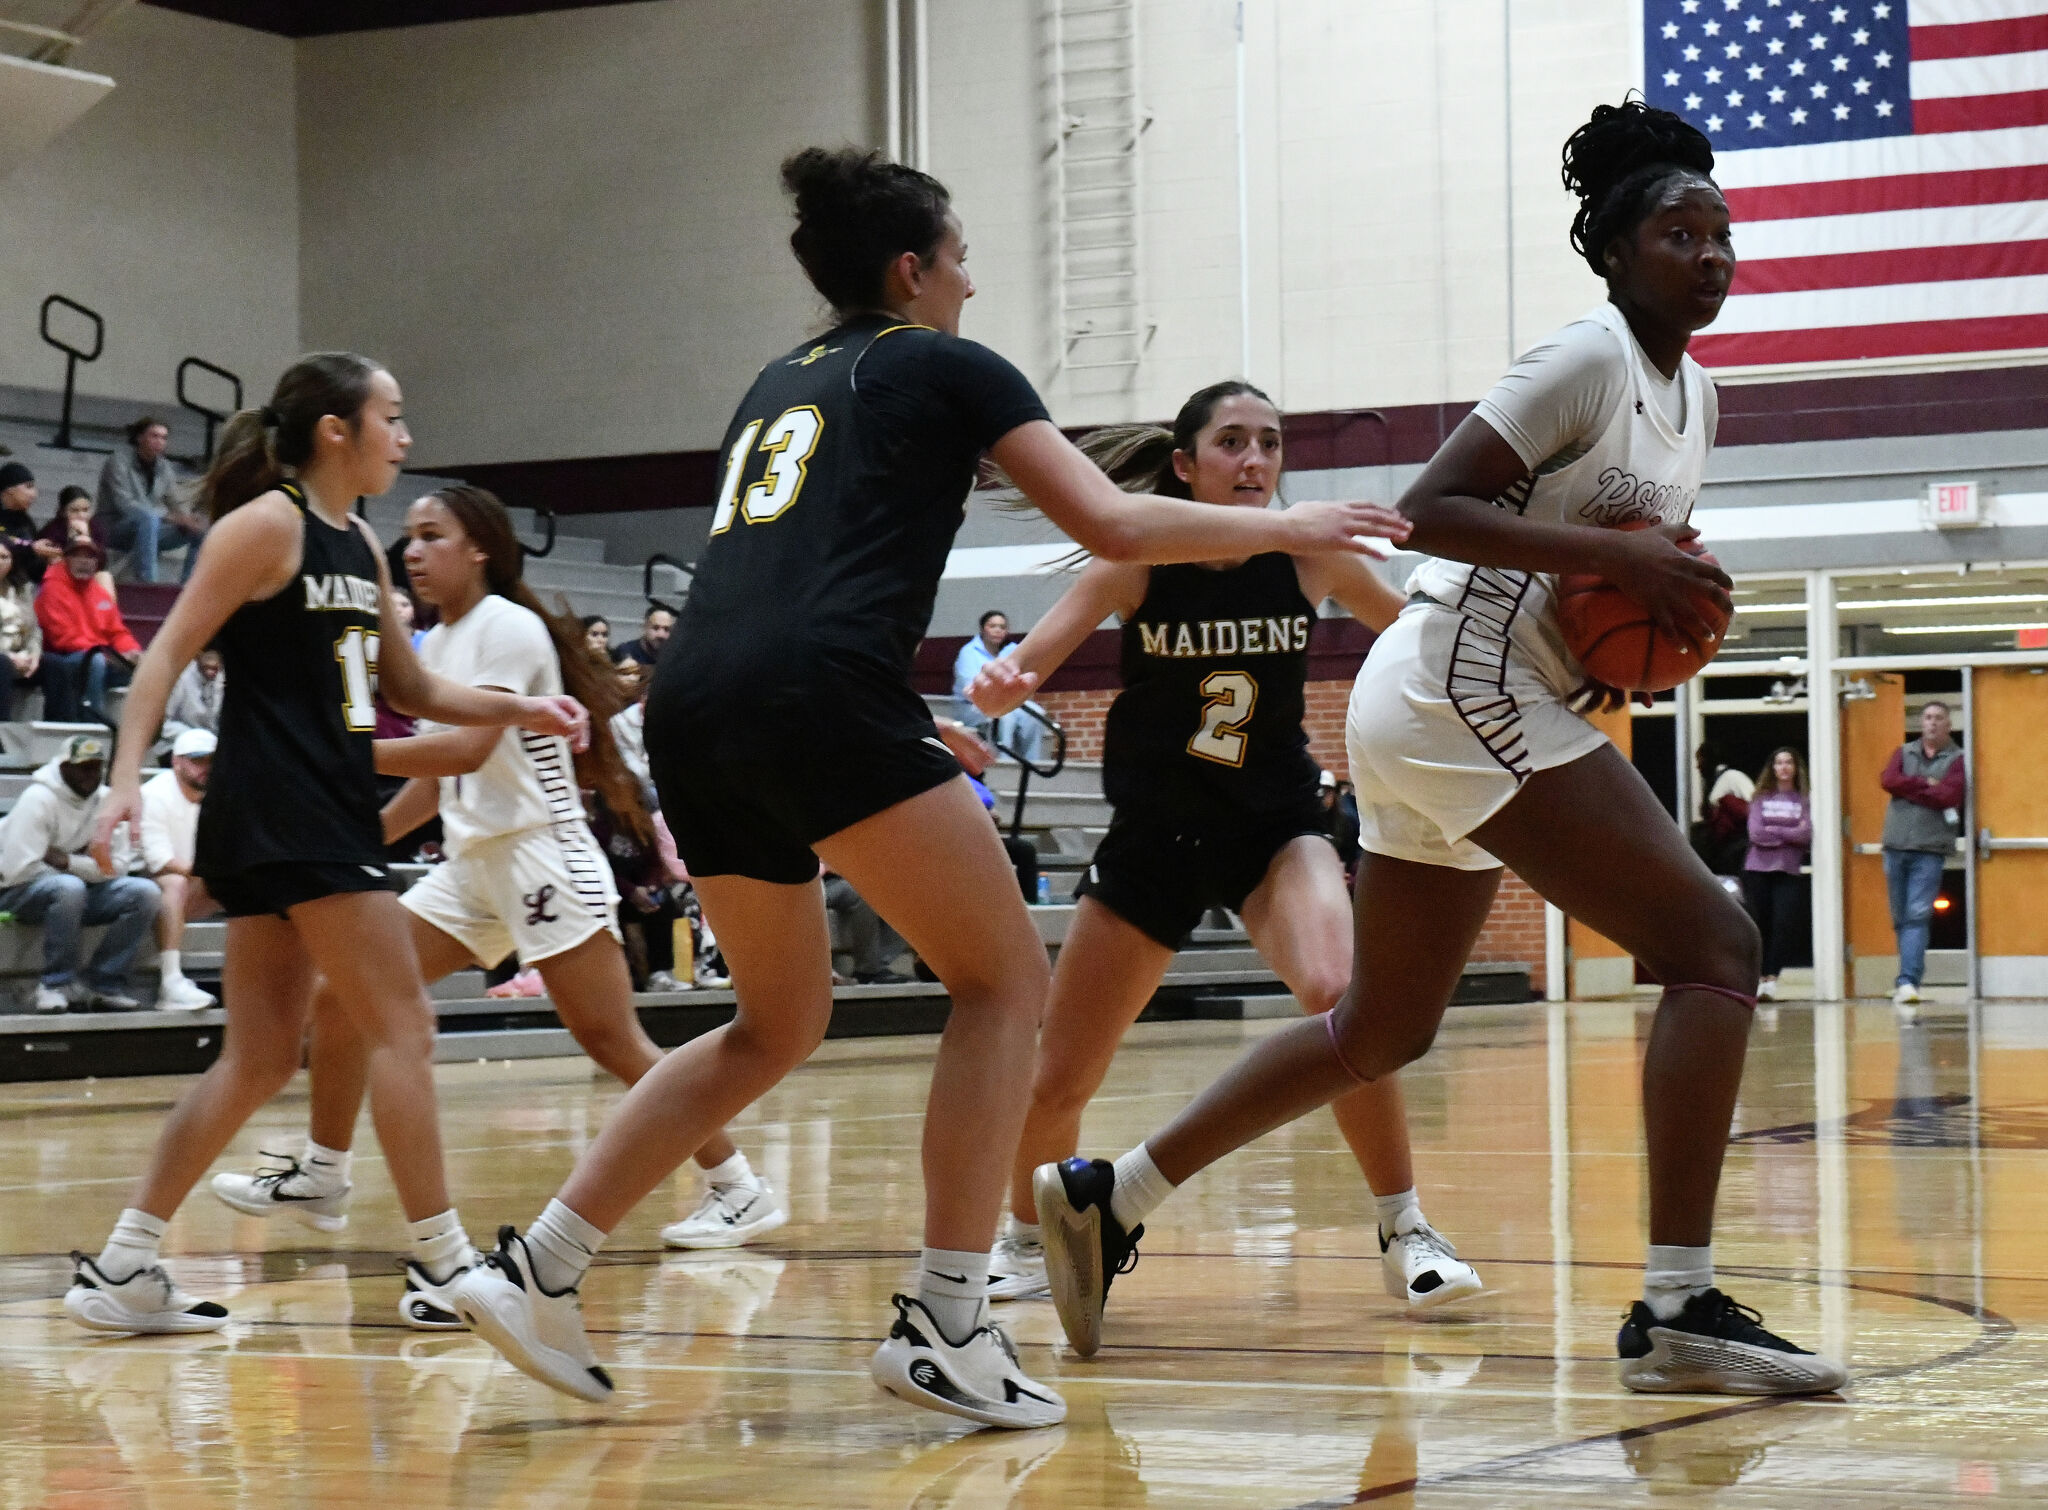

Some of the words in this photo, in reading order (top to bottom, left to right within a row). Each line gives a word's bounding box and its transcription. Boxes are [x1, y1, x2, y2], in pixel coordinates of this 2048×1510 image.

[709, 404, 825, 536] 13
[1938, 485, 1969, 512] EXIT
[303, 574, 381, 615] MAIDE
[1138, 615, 1309, 658] MAIDENS
[1186, 670, 1259, 768] 2
